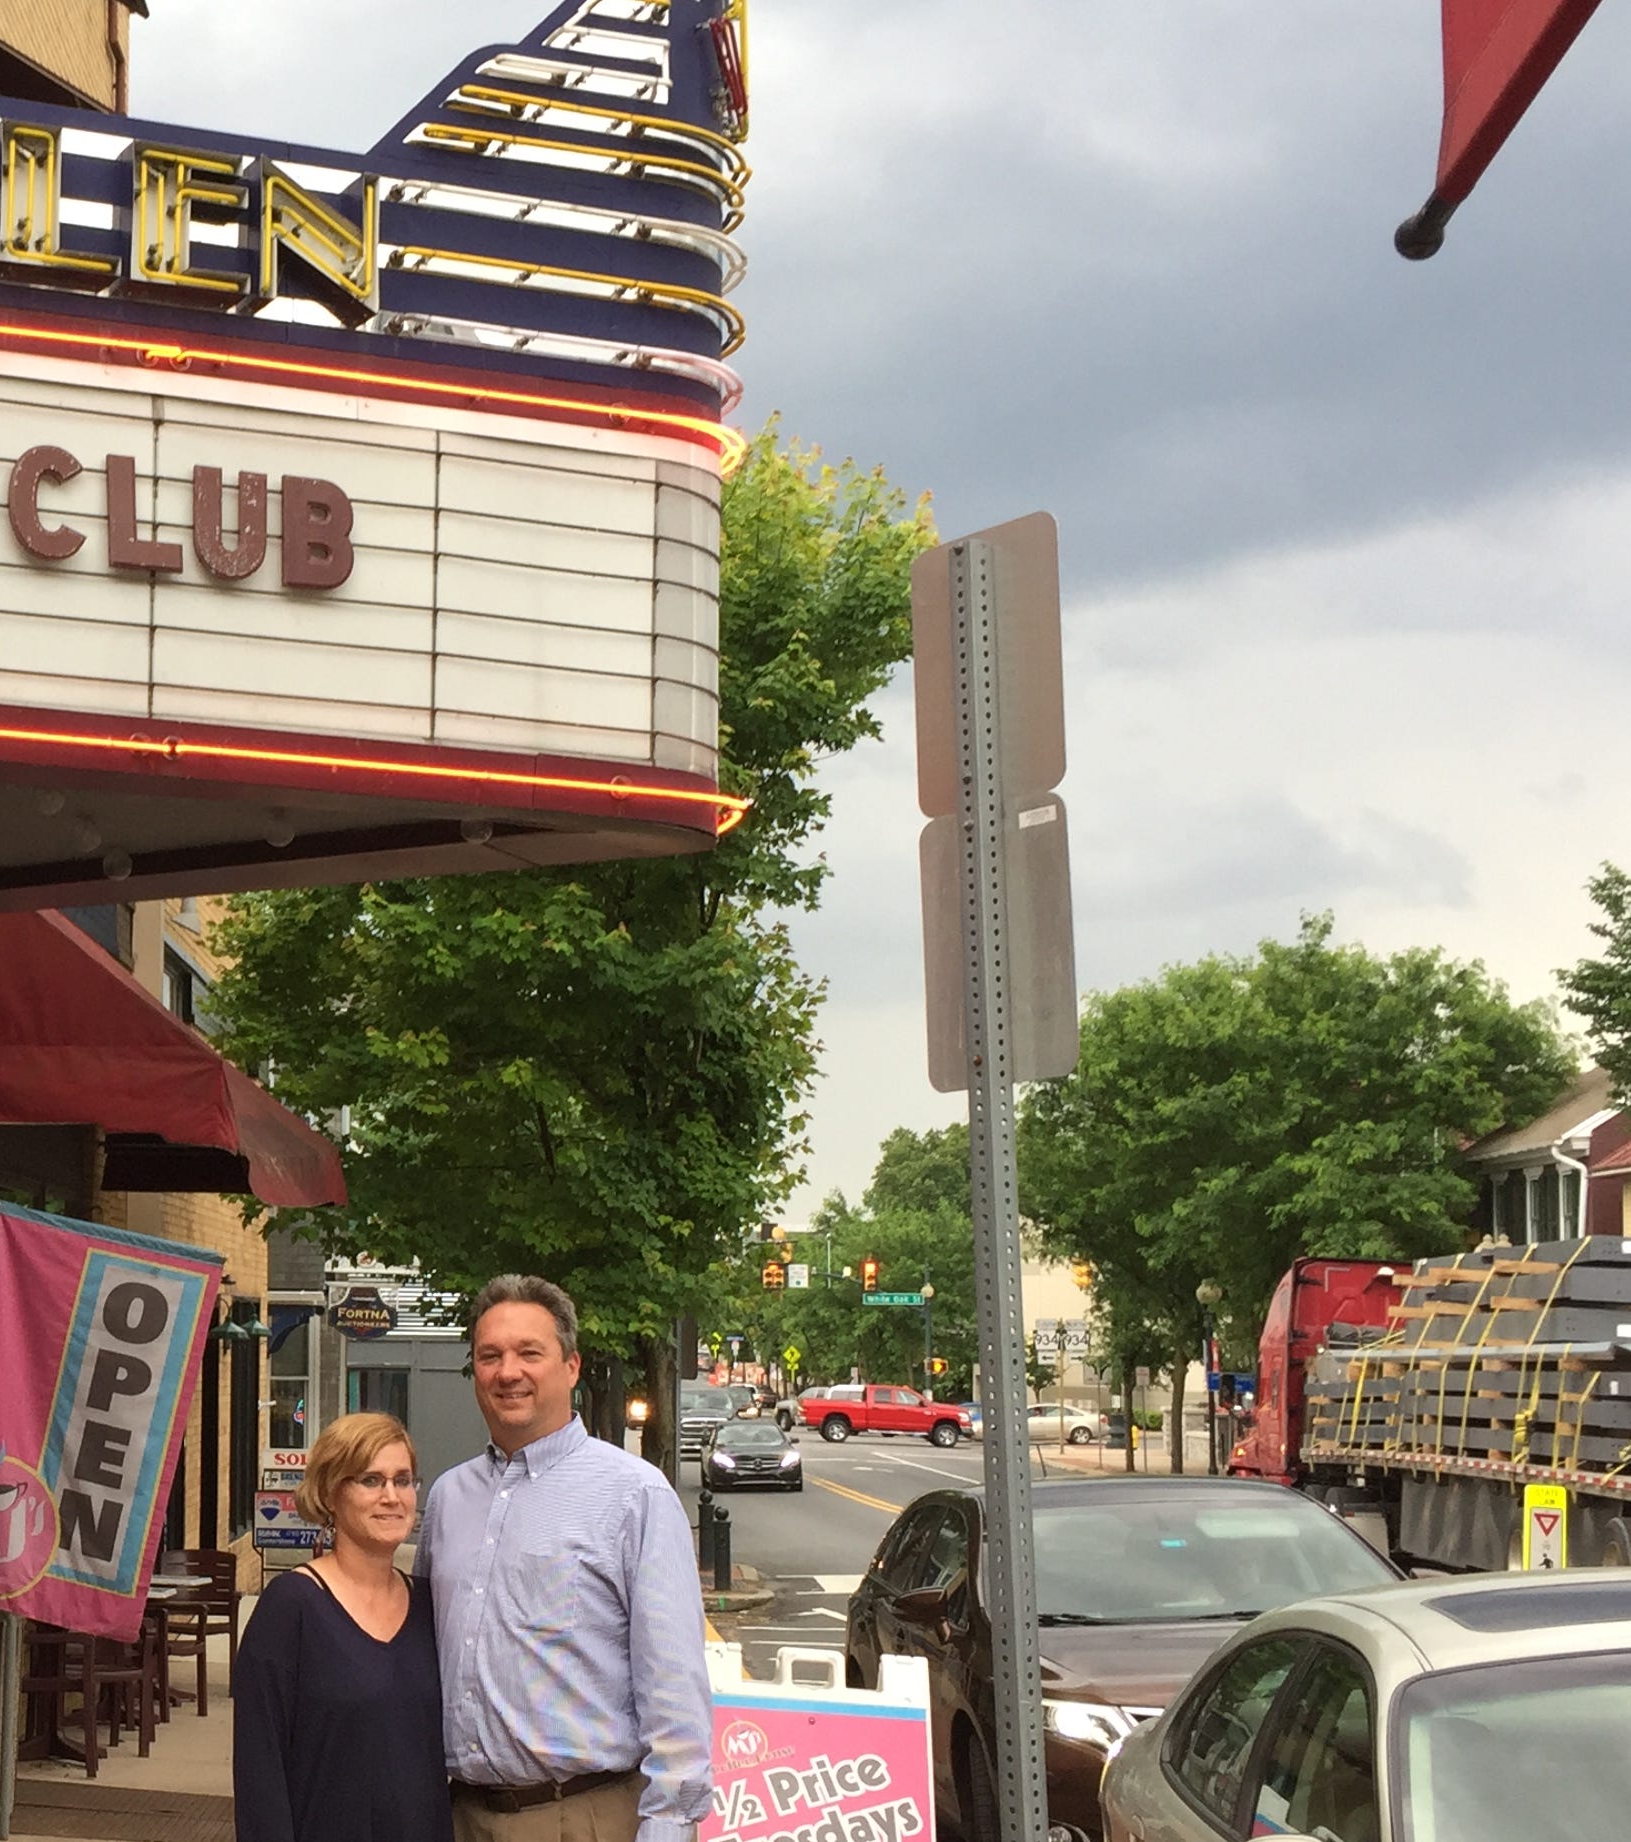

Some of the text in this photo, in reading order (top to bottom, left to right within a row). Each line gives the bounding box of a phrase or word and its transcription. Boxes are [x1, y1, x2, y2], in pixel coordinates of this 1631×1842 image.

[8, 445, 355, 590] CLUB
[893, 1295, 909, 1303] Oak
[337, 1306, 390, 1320] FORTNA
[1035, 1334, 1059, 1345] 934
[1065, 1334, 1088, 1345] 934
[58, 1281, 169, 1563] OPEN
[765, 1755, 889, 1814] Price
